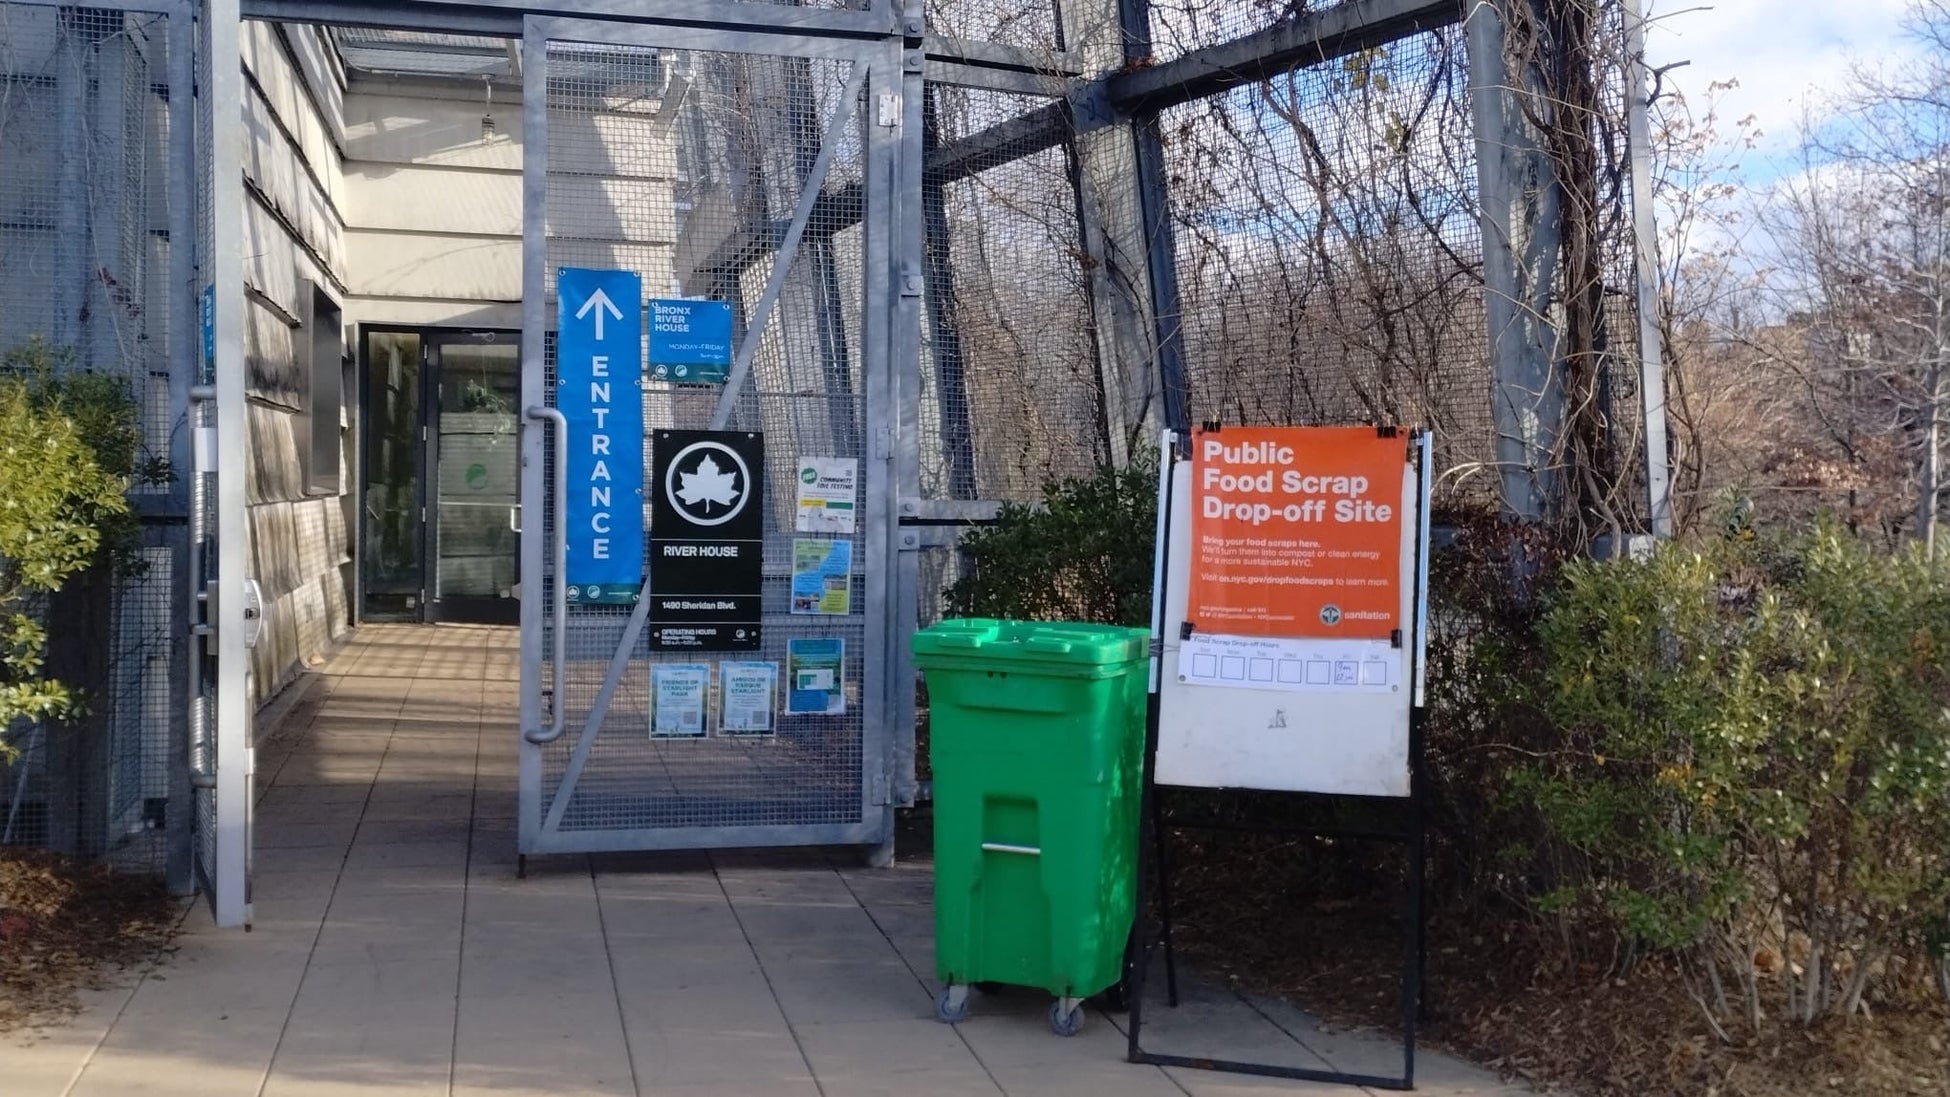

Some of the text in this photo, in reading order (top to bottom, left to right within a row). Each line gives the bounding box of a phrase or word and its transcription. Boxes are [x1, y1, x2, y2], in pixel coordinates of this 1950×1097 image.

[654, 306, 691, 315] BRONX
[655, 315, 685, 324] RIVER
[655, 324, 690, 332] HOUSE
[590, 355, 611, 559] ENTRANCE
[1203, 440, 1295, 465] Public
[1203, 468, 1368, 498] Food Scrap
[1203, 496, 1392, 526] Drop-off Site
[1203, 535, 1320, 548] Bring your food scraps here.
[663, 545, 738, 557] RIVER HOUSE
[1221, 547, 1238, 555] turn
[1240, 547, 1260, 555] them
[1261, 548, 1276, 556] into
[1278, 550, 1315, 559] compost
[1328, 550, 1350, 558] clean
[1352, 551, 1380, 560] energy
[1202, 555, 1213, 563] for
[1243, 558, 1290, 567] sustainable
[1201, 572, 1217, 582] Visit
[1346, 578, 1366, 586] learn
[681, 601, 716, 609] Sheridan
[717, 601, 736, 609] Blvd.
[1344, 610, 1390, 620] sanitation
